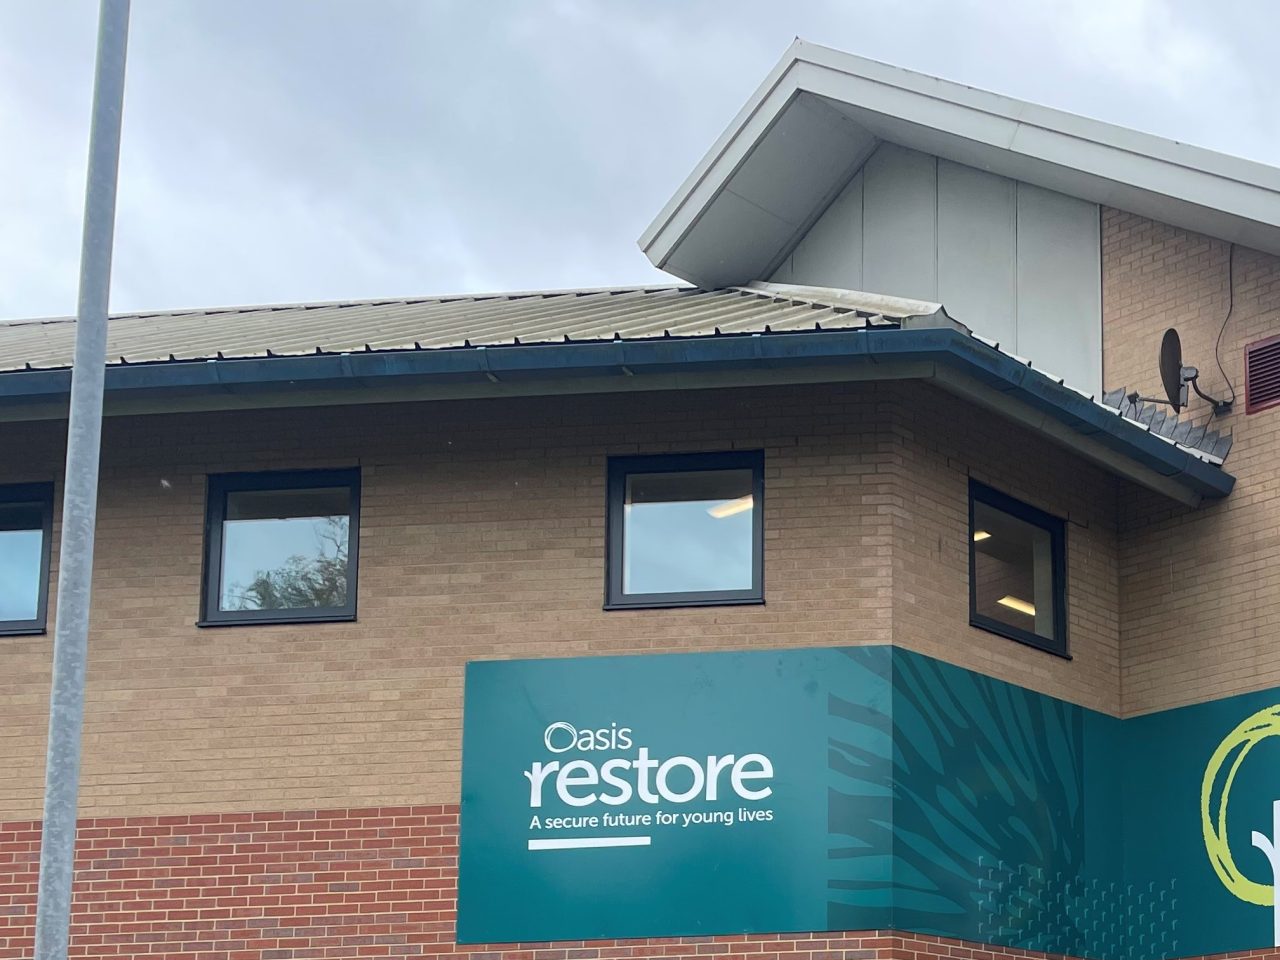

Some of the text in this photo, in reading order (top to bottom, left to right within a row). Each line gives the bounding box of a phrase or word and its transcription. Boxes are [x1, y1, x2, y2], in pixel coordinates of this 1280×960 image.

[545, 721, 632, 753] Oasis
[524, 747, 774, 807] restore
[529, 807, 773, 830] A secure future for young lives
